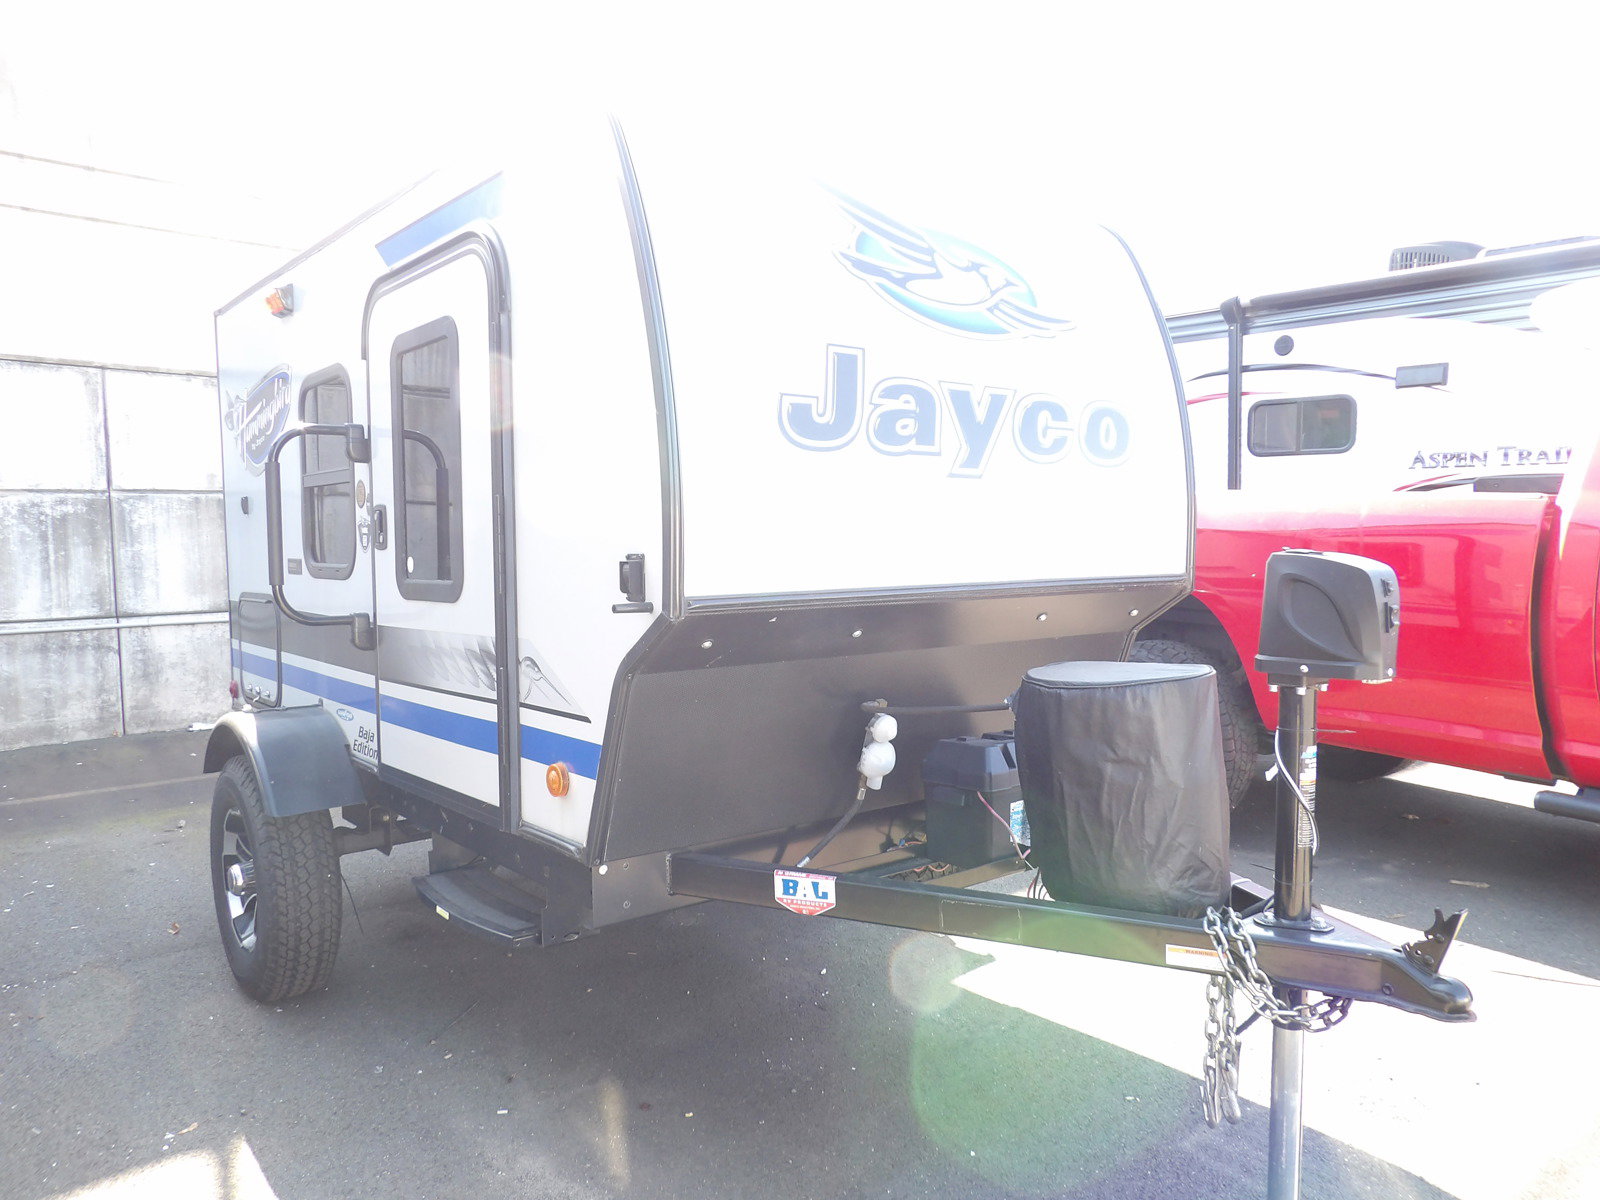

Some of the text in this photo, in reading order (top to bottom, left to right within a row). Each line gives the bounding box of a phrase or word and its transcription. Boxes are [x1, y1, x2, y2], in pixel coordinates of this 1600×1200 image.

[777, 343, 1133, 480] Jayco
[1408, 450, 1489, 470] ASPEN
[358, 726, 375, 743] Baja
[353, 740, 378, 760] Edition
[782, 878, 828, 900] BAL
